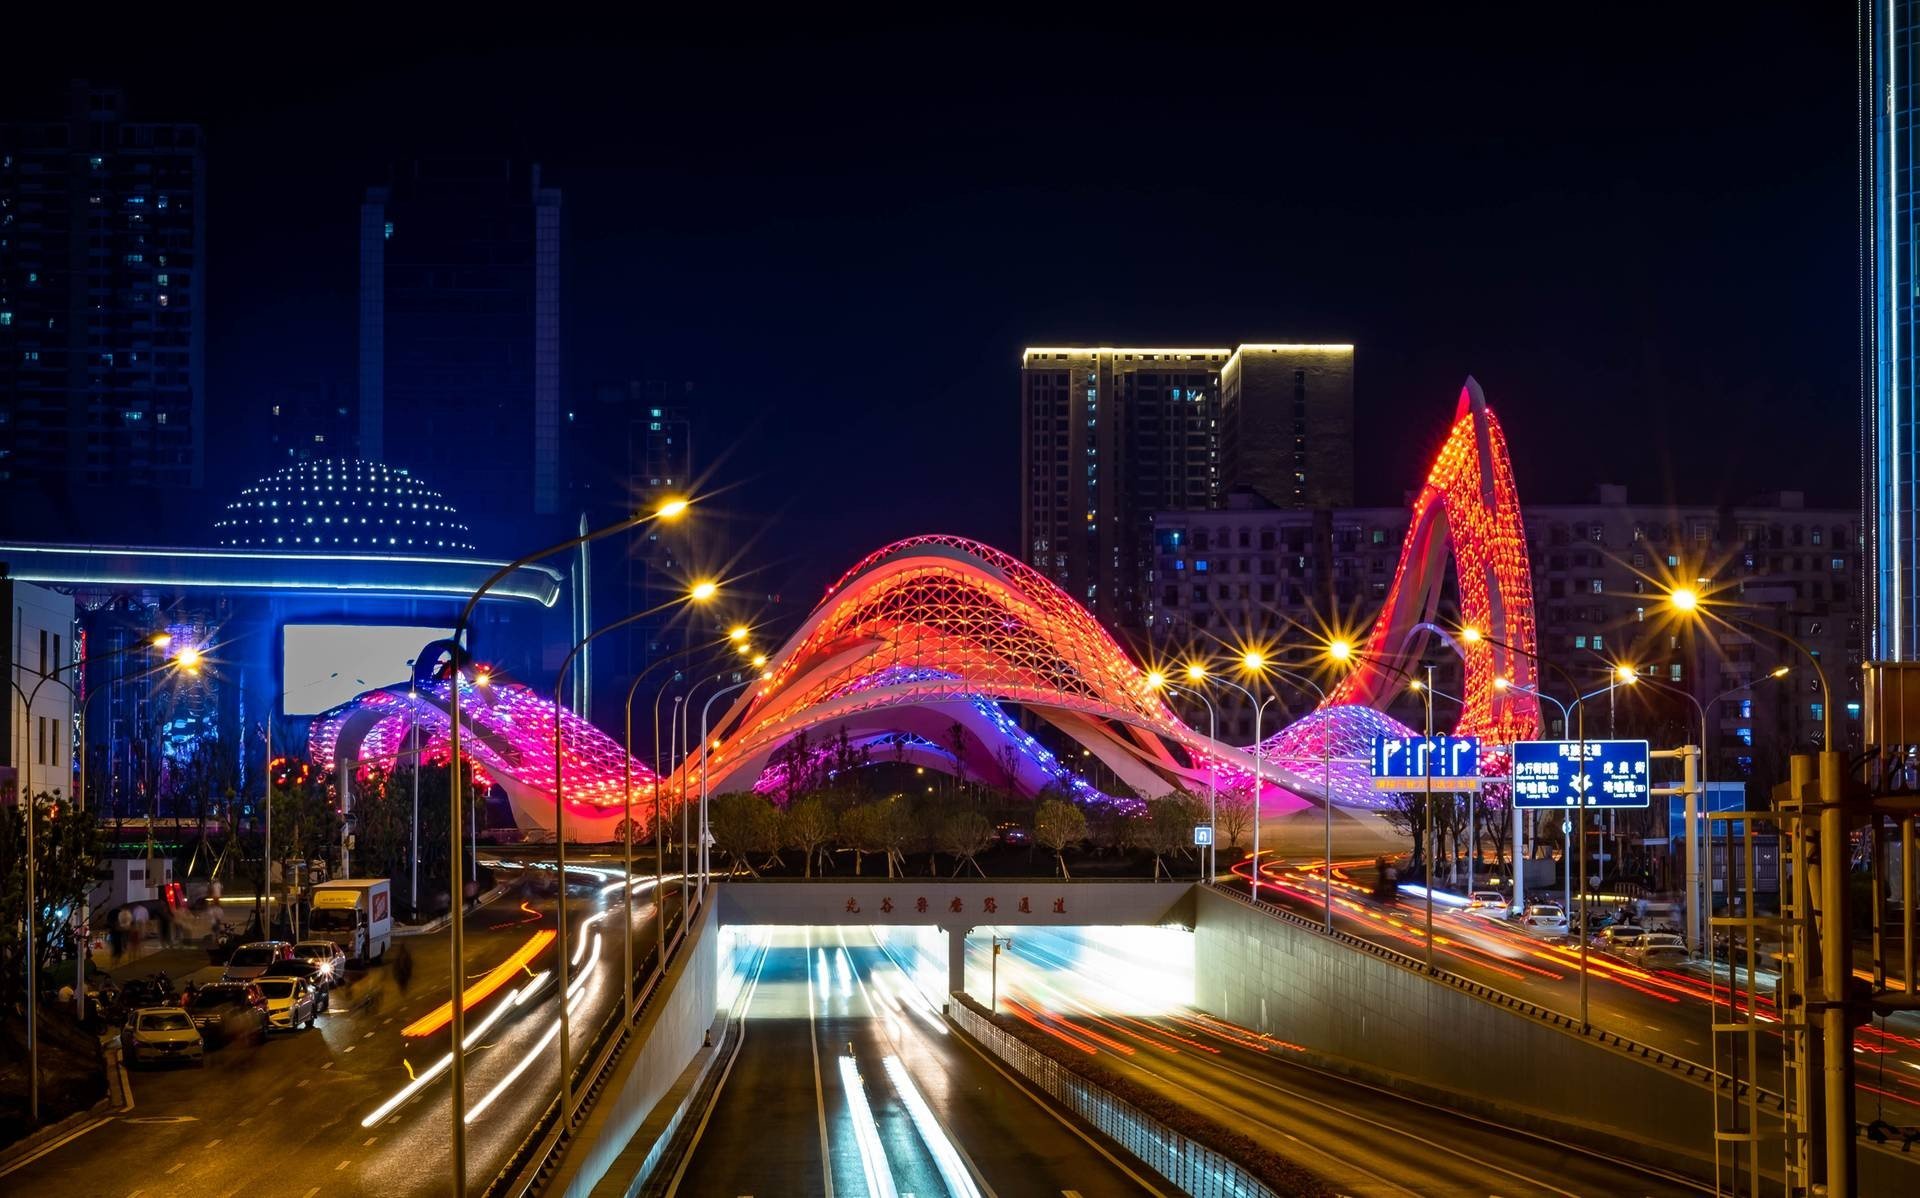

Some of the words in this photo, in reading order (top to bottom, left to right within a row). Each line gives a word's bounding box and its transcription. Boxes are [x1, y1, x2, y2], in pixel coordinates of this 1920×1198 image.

[1603, 761, 1645, 774] 虎泉街
[845, 896, 1068, 914] 光谷鲁磨路通道
